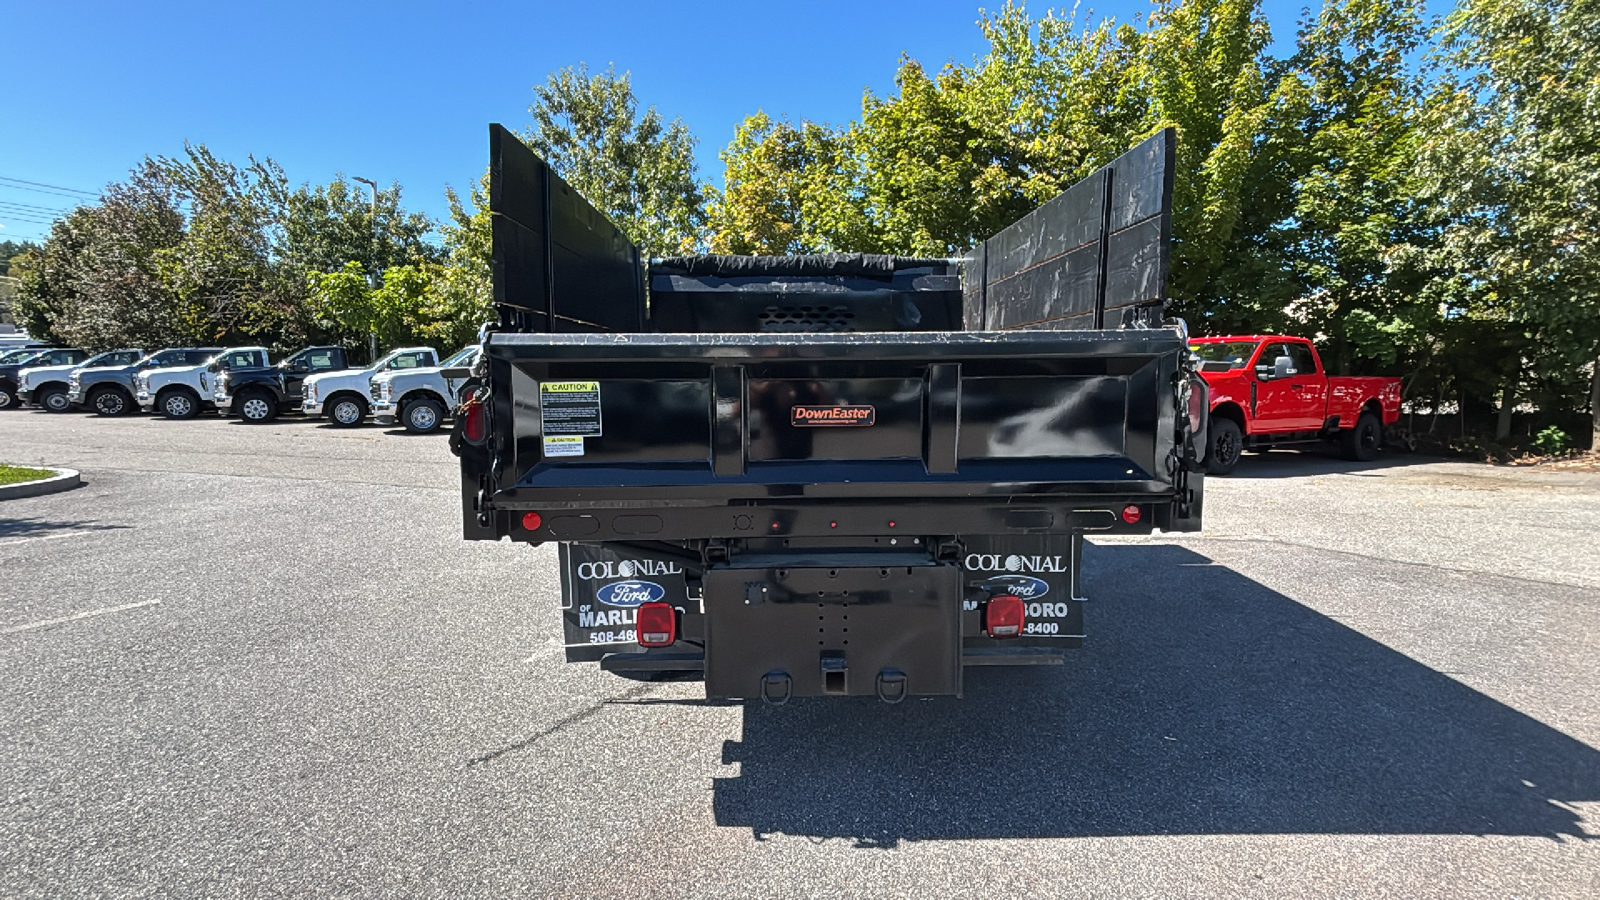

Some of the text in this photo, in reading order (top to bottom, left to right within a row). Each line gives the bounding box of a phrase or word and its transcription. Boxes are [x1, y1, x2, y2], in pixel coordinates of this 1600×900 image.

[552, 383, 588, 391] CAUTION
[795, 407, 871, 419] DownEaster
[577, 559, 683, 580] COLONIAL
[964, 553, 1068, 573] COLONIAL
[610, 583, 652, 603] Ford
[1007, 581, 1037, 596] ord
[579, 604, 592, 613] OF
